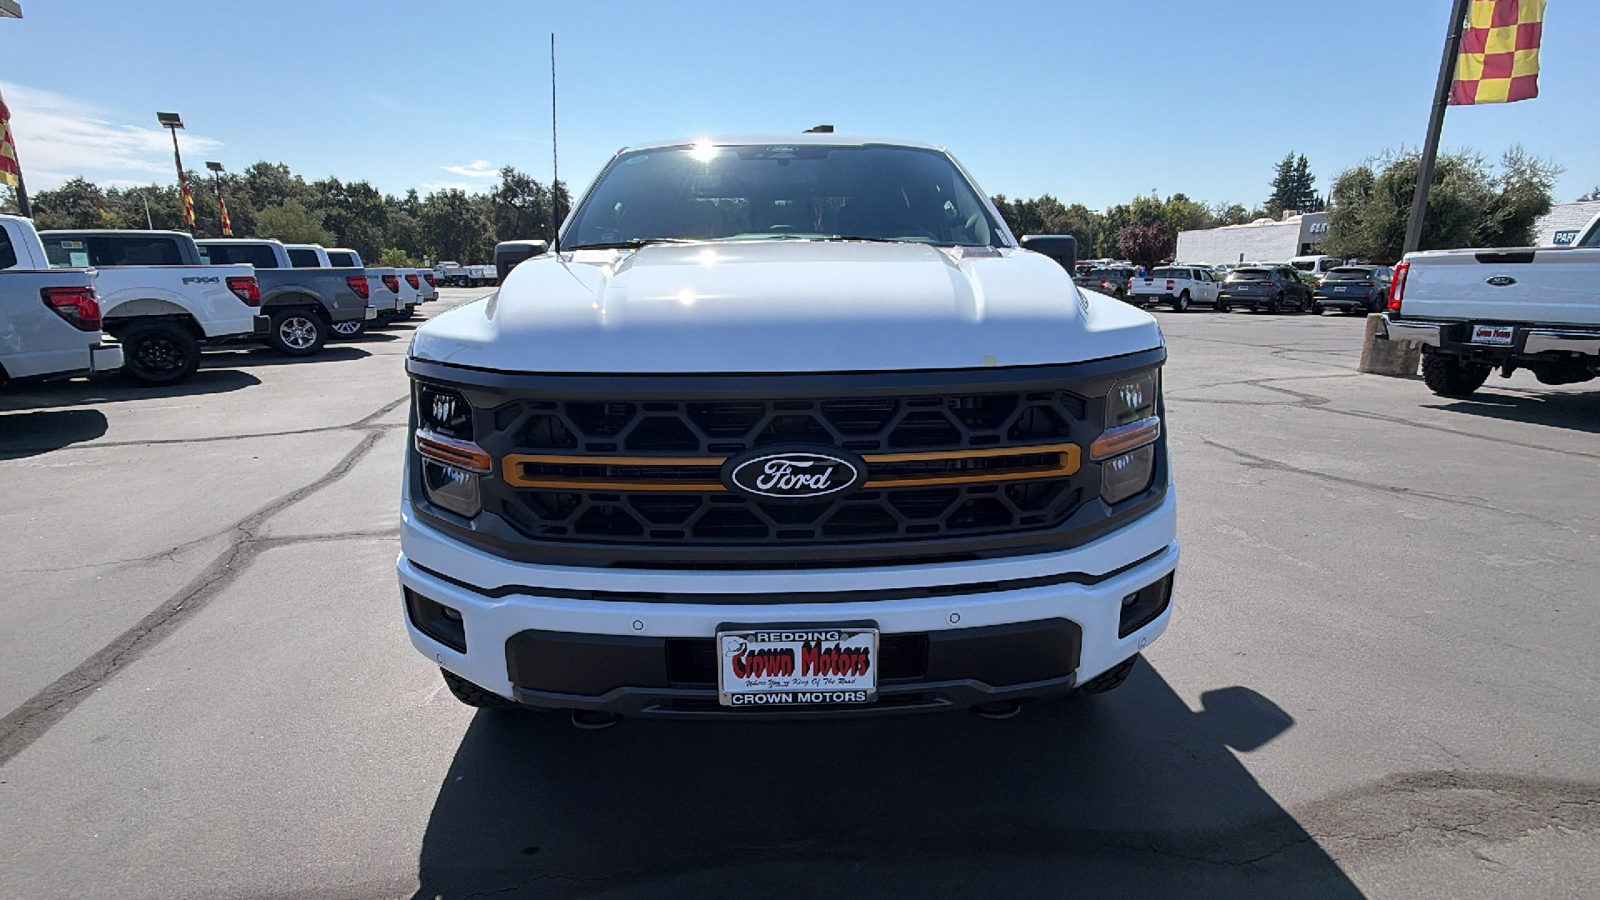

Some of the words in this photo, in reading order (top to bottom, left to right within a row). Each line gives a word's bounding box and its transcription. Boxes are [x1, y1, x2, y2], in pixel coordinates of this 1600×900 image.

[756, 460, 833, 489] Ford
[757, 632, 839, 642] REDDING
[732, 643, 795, 679] Crown
[801, 640, 870, 677] Motors
[732, 693, 793, 704] CROWN
[797, 692, 866, 702] MOTORS
